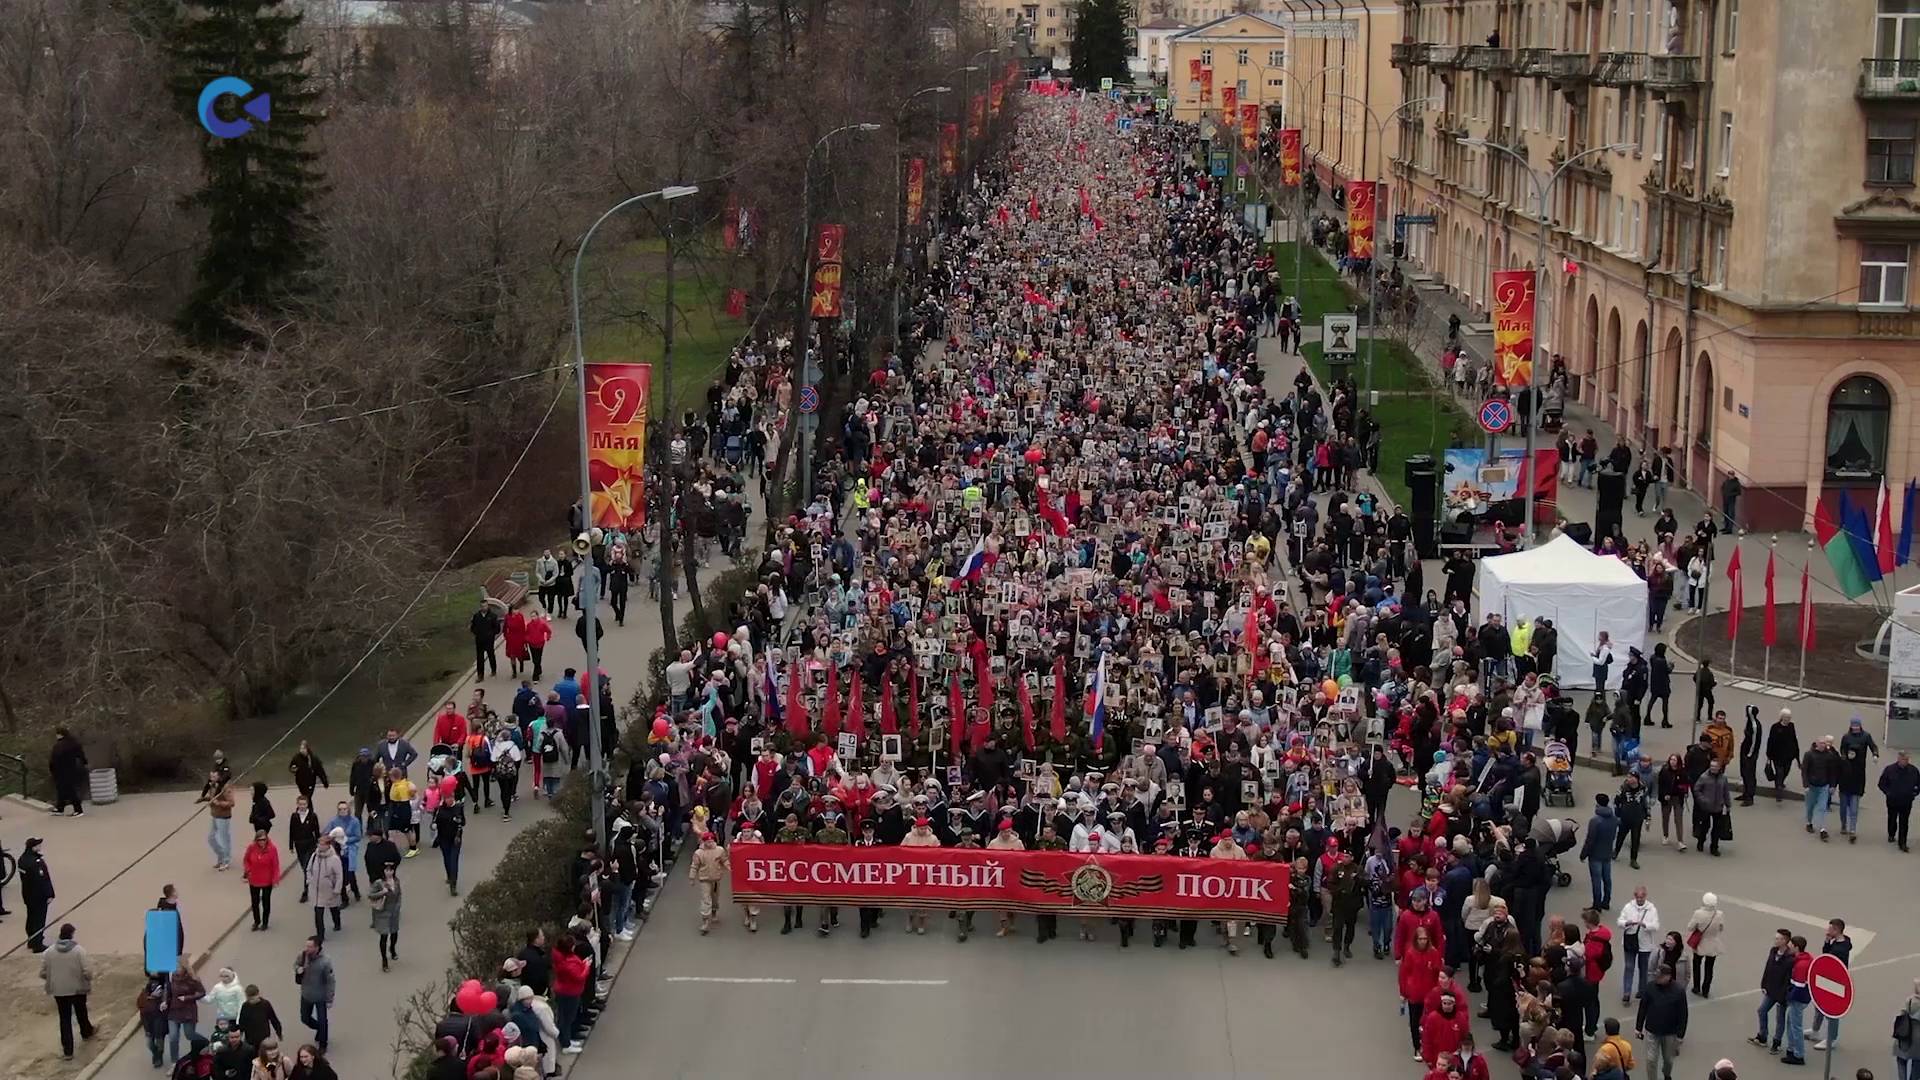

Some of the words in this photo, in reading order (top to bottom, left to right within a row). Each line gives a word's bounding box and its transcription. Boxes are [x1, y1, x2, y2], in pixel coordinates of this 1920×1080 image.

[1281, 134, 1296, 151] 9
[1349, 187, 1370, 211] 9
[818, 231, 841, 260] 9
[1496, 279, 1527, 315] 9
[1497, 319, 1531, 332] Мая
[599, 376, 643, 426] 9
[592, 432, 640, 450] Мая
[746, 859, 1005, 888] БЕССМЕРТНЫЙ
[1176, 873, 1273, 901] ПОЛК
